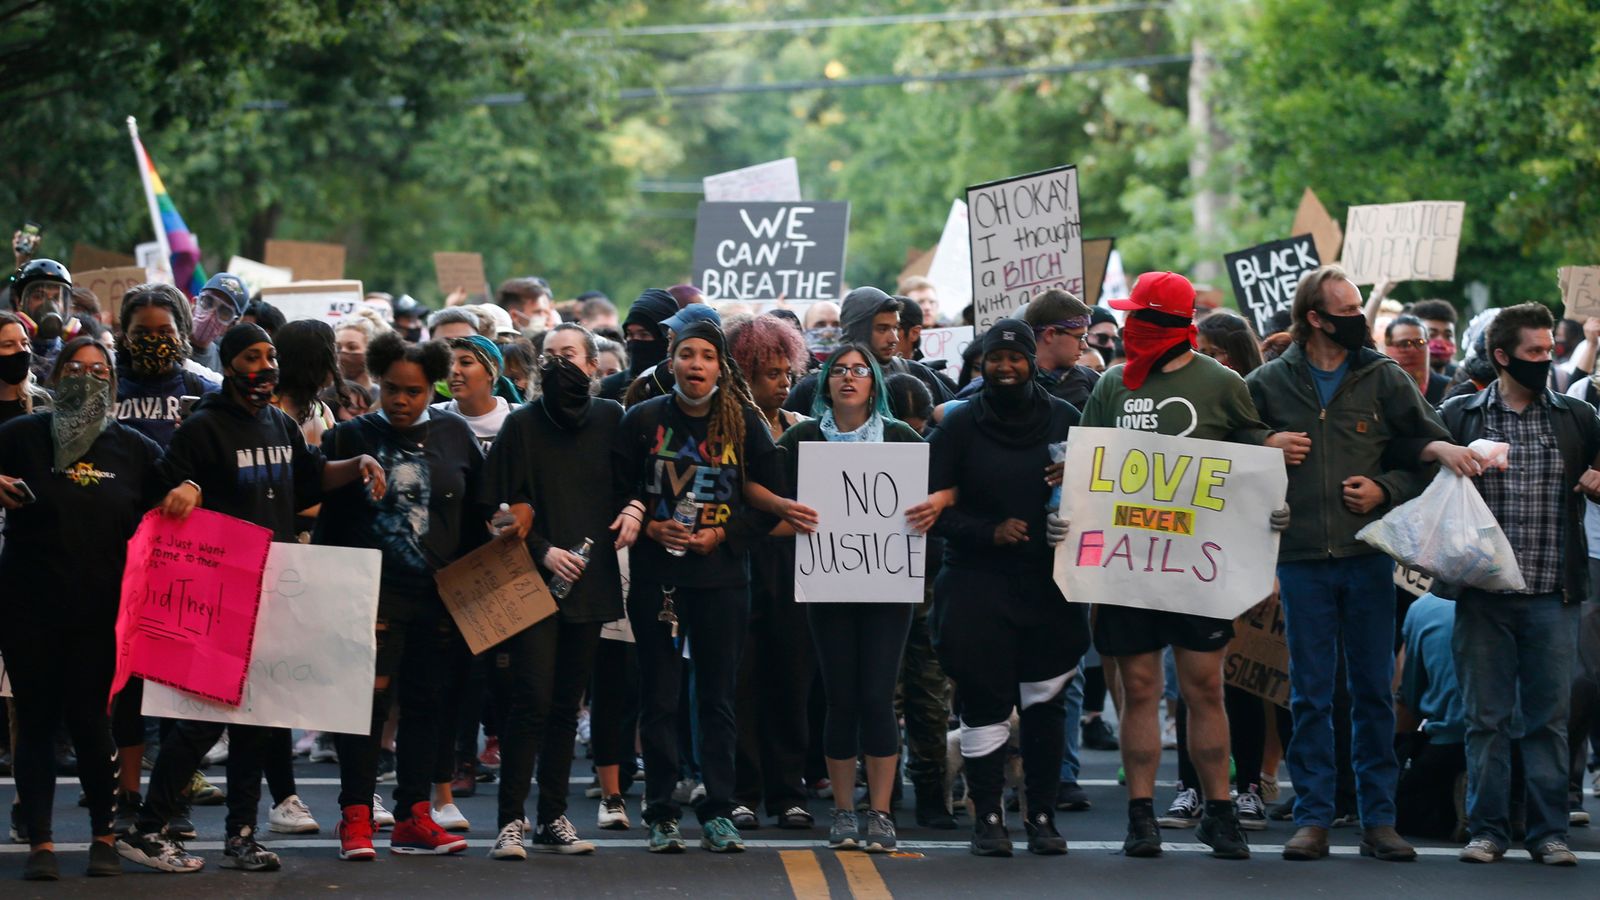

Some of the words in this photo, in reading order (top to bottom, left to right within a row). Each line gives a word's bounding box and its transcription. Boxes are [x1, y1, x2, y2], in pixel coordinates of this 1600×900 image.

[739, 206, 816, 239] WE
[975, 188, 1011, 228] OH
[1351, 207, 1380, 235] NO
[1386, 204, 1459, 237] JUSTICE
[716, 239, 817, 268] CAN'T
[978, 233, 1000, 264] I
[1014, 214, 1080, 254] thought
[1345, 237, 1374, 278] NO
[1378, 236, 1449, 279] PEACE
[981, 270, 996, 288] a
[1003, 252, 1062, 288] BITCH
[1235, 241, 1319, 288] BLACK
[702, 268, 837, 300] BREATHE
[1244, 269, 1312, 309] LIVE
[1116, 414, 1158, 429] LOVES
[1124, 398, 1154, 413] GOD
[236, 445, 293, 475] NAVY
[1089, 446, 1232, 512] LOVE
[842, 470, 899, 518] NO
[1115, 505, 1192, 535] NEVER
[800, 532, 925, 579] JUSTICE
[1076, 530, 1222, 582] FAILS
